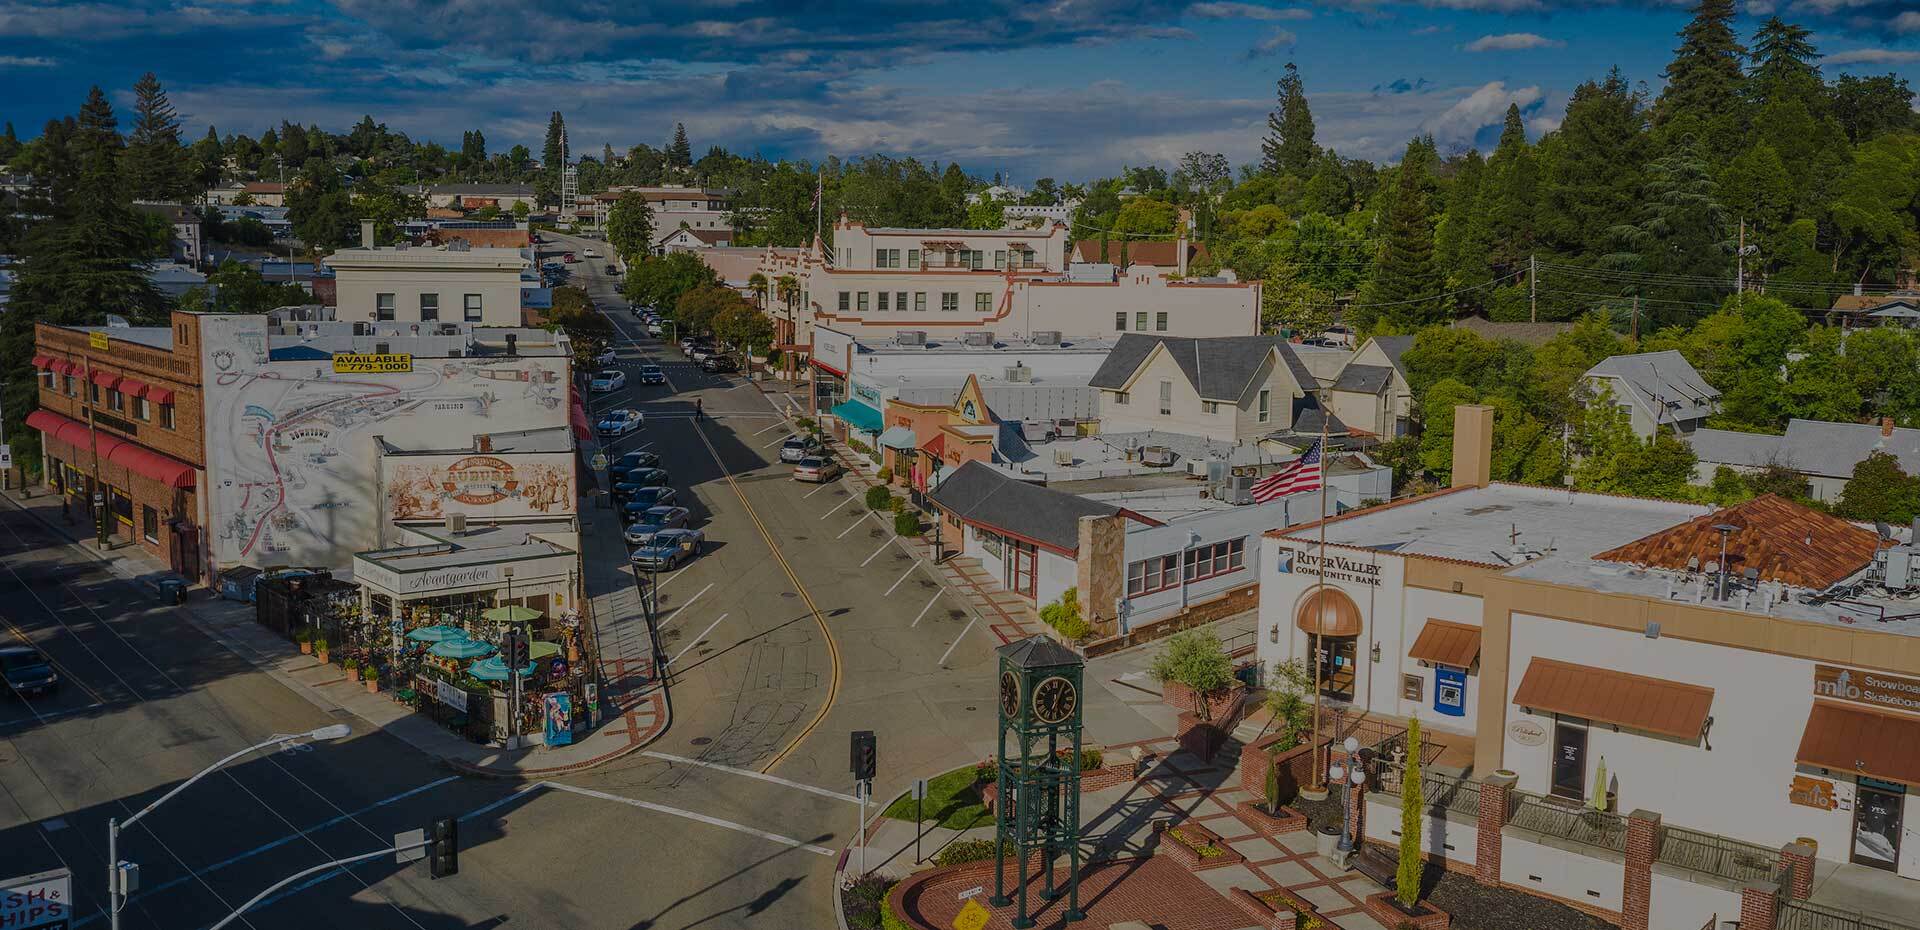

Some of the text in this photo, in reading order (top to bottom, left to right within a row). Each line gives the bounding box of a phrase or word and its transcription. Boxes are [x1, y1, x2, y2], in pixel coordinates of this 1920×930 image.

[349, 363, 409, 371] 779-1000
[410, 567, 489, 589] Avantgarden
[1355, 575, 1381, 587] BANK
[1816, 670, 1861, 699] milo
[1864, 675, 1920, 694] Snowboa
[0, 888, 60, 908] SH &
